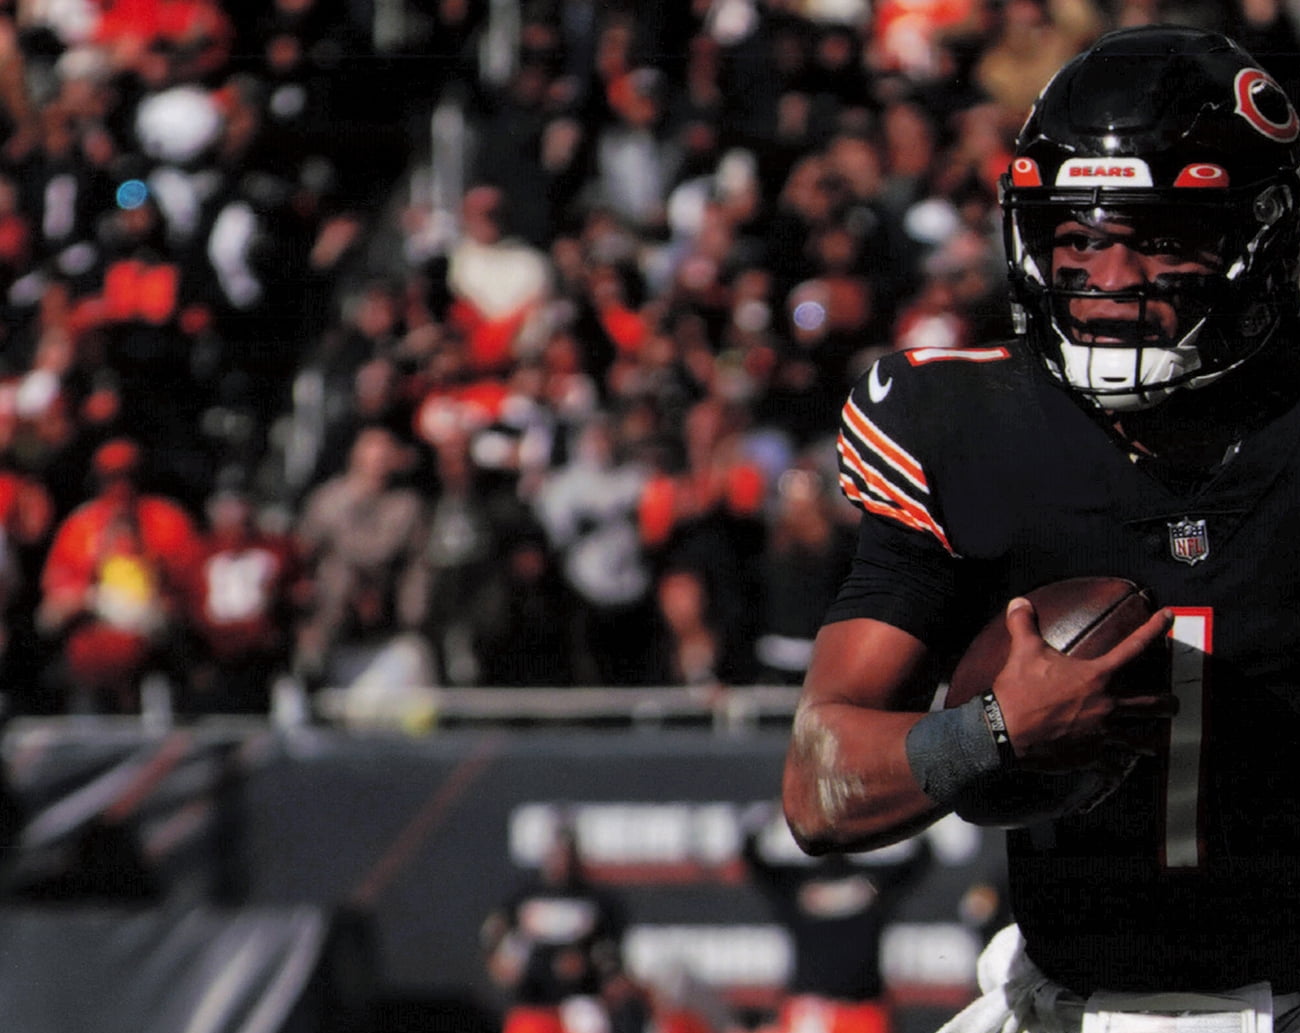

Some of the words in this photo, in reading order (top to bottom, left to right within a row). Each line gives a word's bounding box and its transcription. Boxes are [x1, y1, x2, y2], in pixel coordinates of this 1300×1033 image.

[1069, 166, 1136, 178] BEARS
[1174, 537, 1206, 558] NFL
[1161, 606, 1213, 868] 1
